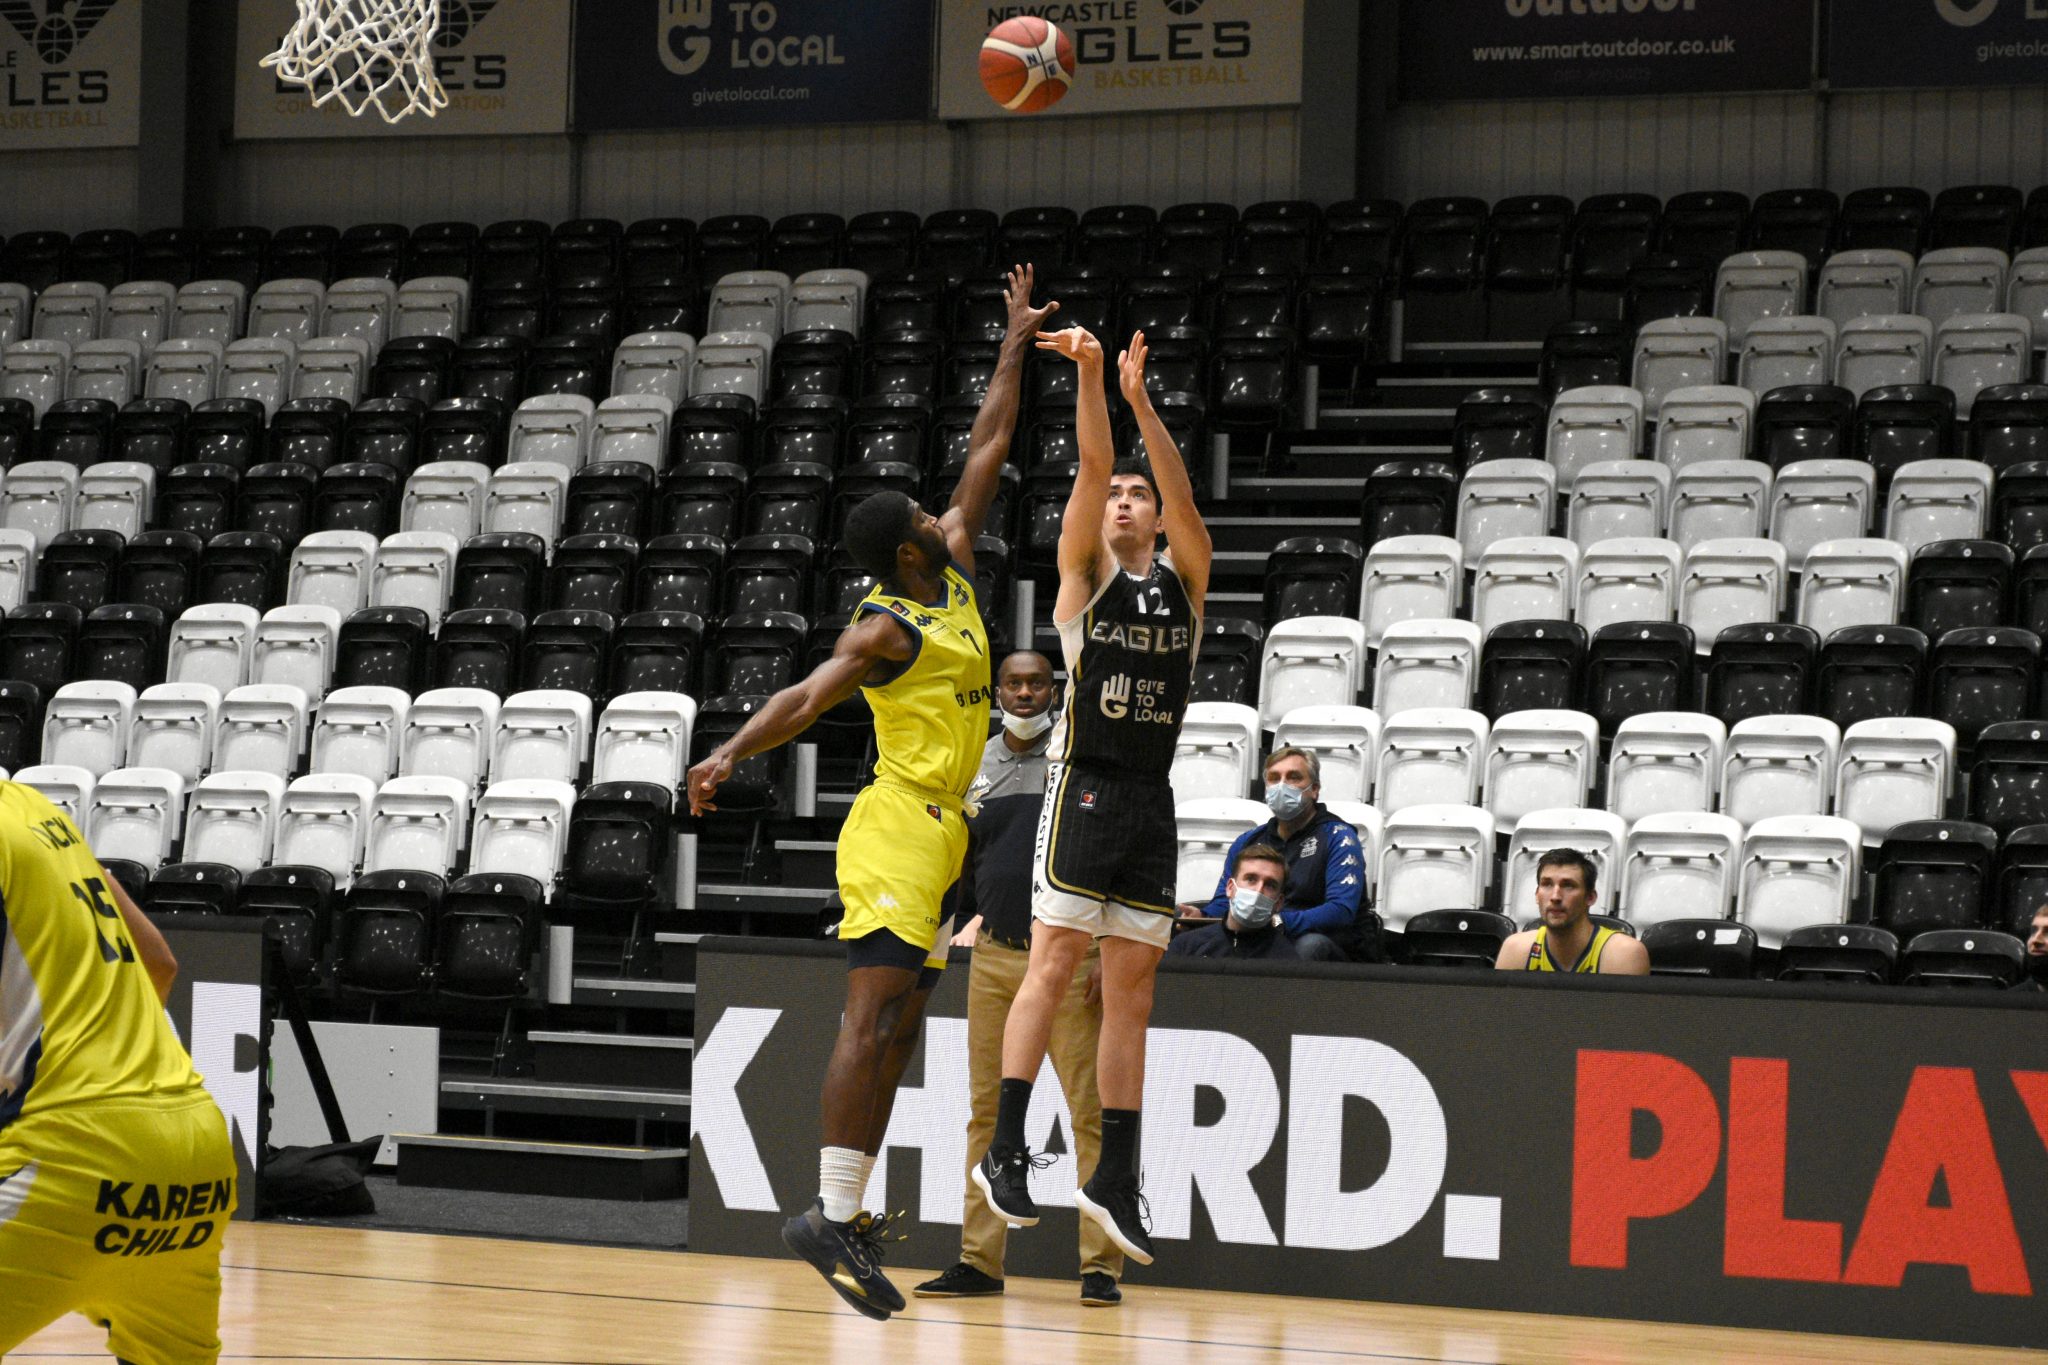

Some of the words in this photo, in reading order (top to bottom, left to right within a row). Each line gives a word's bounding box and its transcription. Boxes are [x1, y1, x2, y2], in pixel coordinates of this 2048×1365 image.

[729, 2, 778, 33] TO
[988, 1, 1137, 27] NEWCASTLE
[730, 34, 846, 68] LOCAL
[1075, 21, 1251, 64] GLES
[1472, 35, 1737, 61] www.smartoutdoor.co.uk
[1094, 64, 1249, 89] BASKETBALL
[692, 85, 811, 106] givetolocal.com
[1137, 586, 1170, 616] 12
[959, 628, 984, 657] 7
[1136, 679, 1166, 695] GIVE
[1136, 693, 1155, 708] TO
[1134, 708, 1174, 725] LOCAL
[842, 1014, 1502, 1260] HARD.
[95, 1176, 231, 1222] KAREN
[94, 1220, 214, 1256] CHILD
